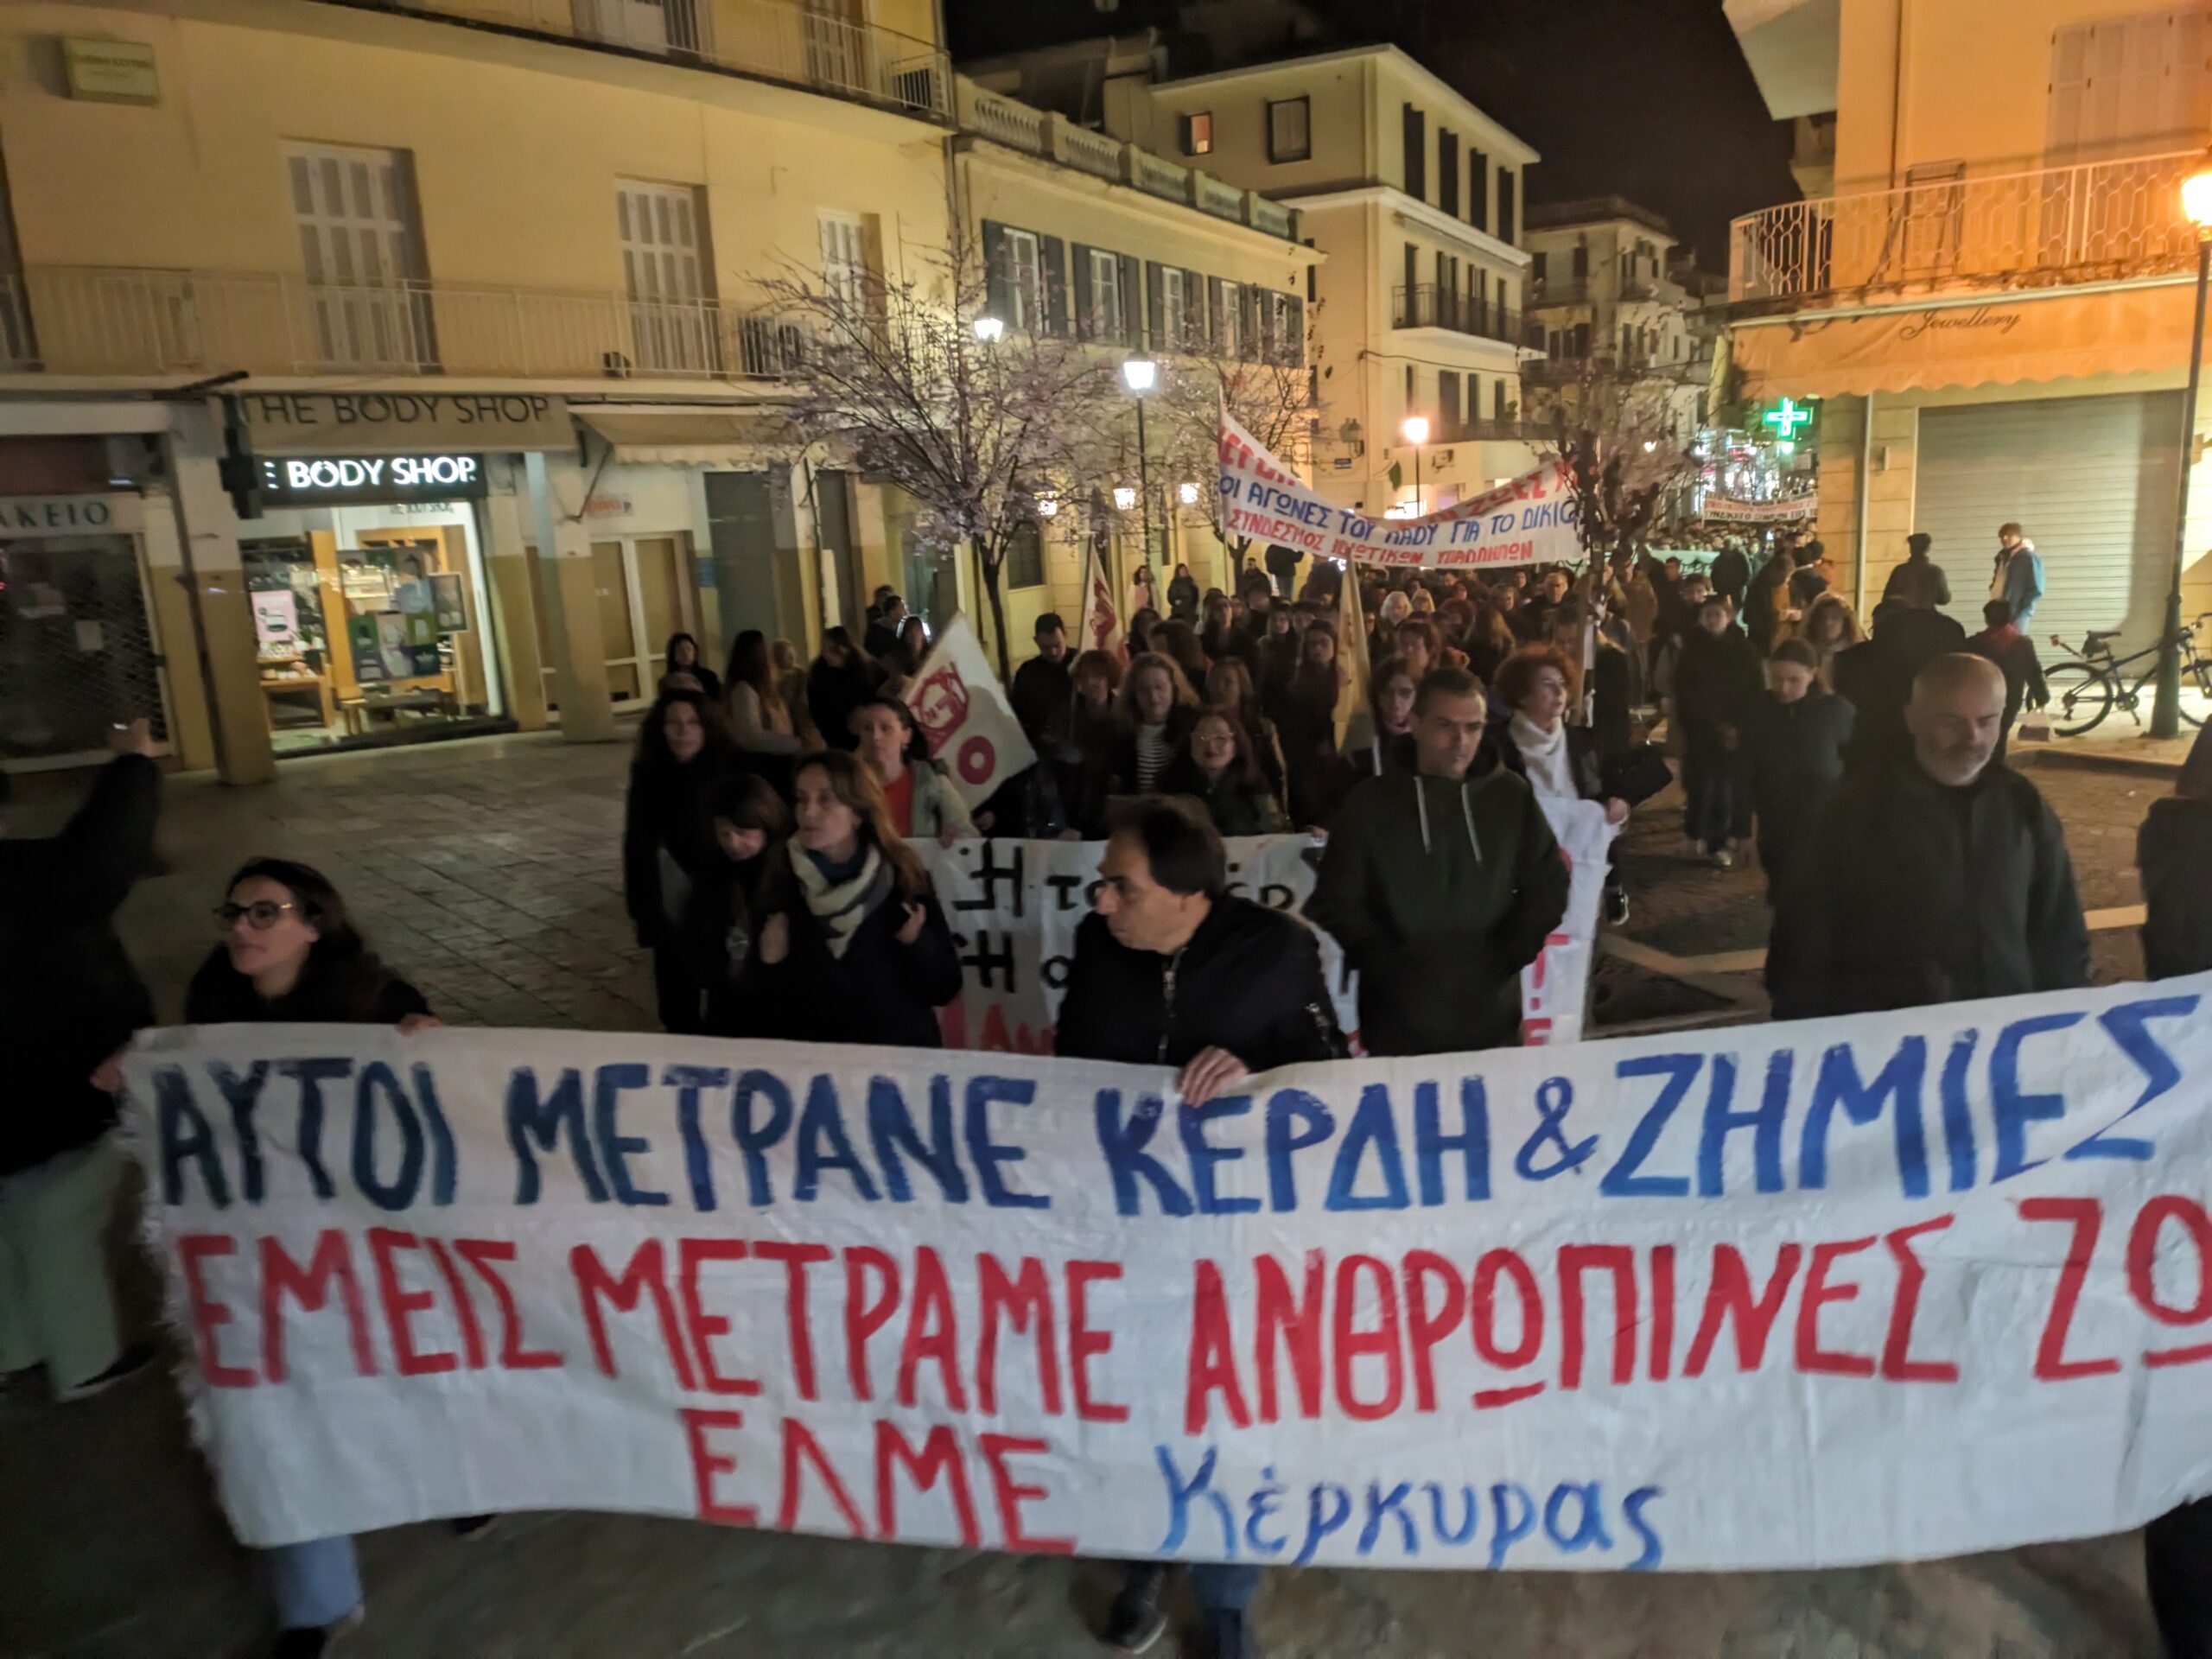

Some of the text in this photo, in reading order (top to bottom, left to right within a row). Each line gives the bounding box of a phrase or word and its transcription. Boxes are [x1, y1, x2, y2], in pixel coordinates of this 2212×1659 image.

[1899, 306, 2021, 340] Jewellery
[241, 395, 550, 424] THE BODY SHOP
[286, 458, 385, 488] BODY
[1219, 475, 1241, 499] ΟΙ
[1248, 481, 1332, 529] ΑΓΩΝΕΣ
[1338, 509, 1377, 541] ΤΟΥ
[1450, 519, 1480, 543] ΓΙΑ
[1491, 513, 1515, 536] ΤΟ
[151, 1058, 457, 1211] ΑΥΤΟΙ
[506, 1064, 1052, 1211] ΜΕΤΡΑΝΕ
[1095, 1075, 1491, 1217] ΚΕΡΔΗ
[1599, 994, 2202, 1198] ΖΗΜΙΕΣ
[175, 1226, 565, 1389] ΕΜΕΙΣ
[569, 1237, 1130, 1423] ΜΕΤΡΑΜΕ
[1183, 1212, 1961, 1437] ΑΝΘΡΩΠΙΝΕΣ
[678, 1407, 1667, 1571] ΕΛΜΕ Κέρκυρας
